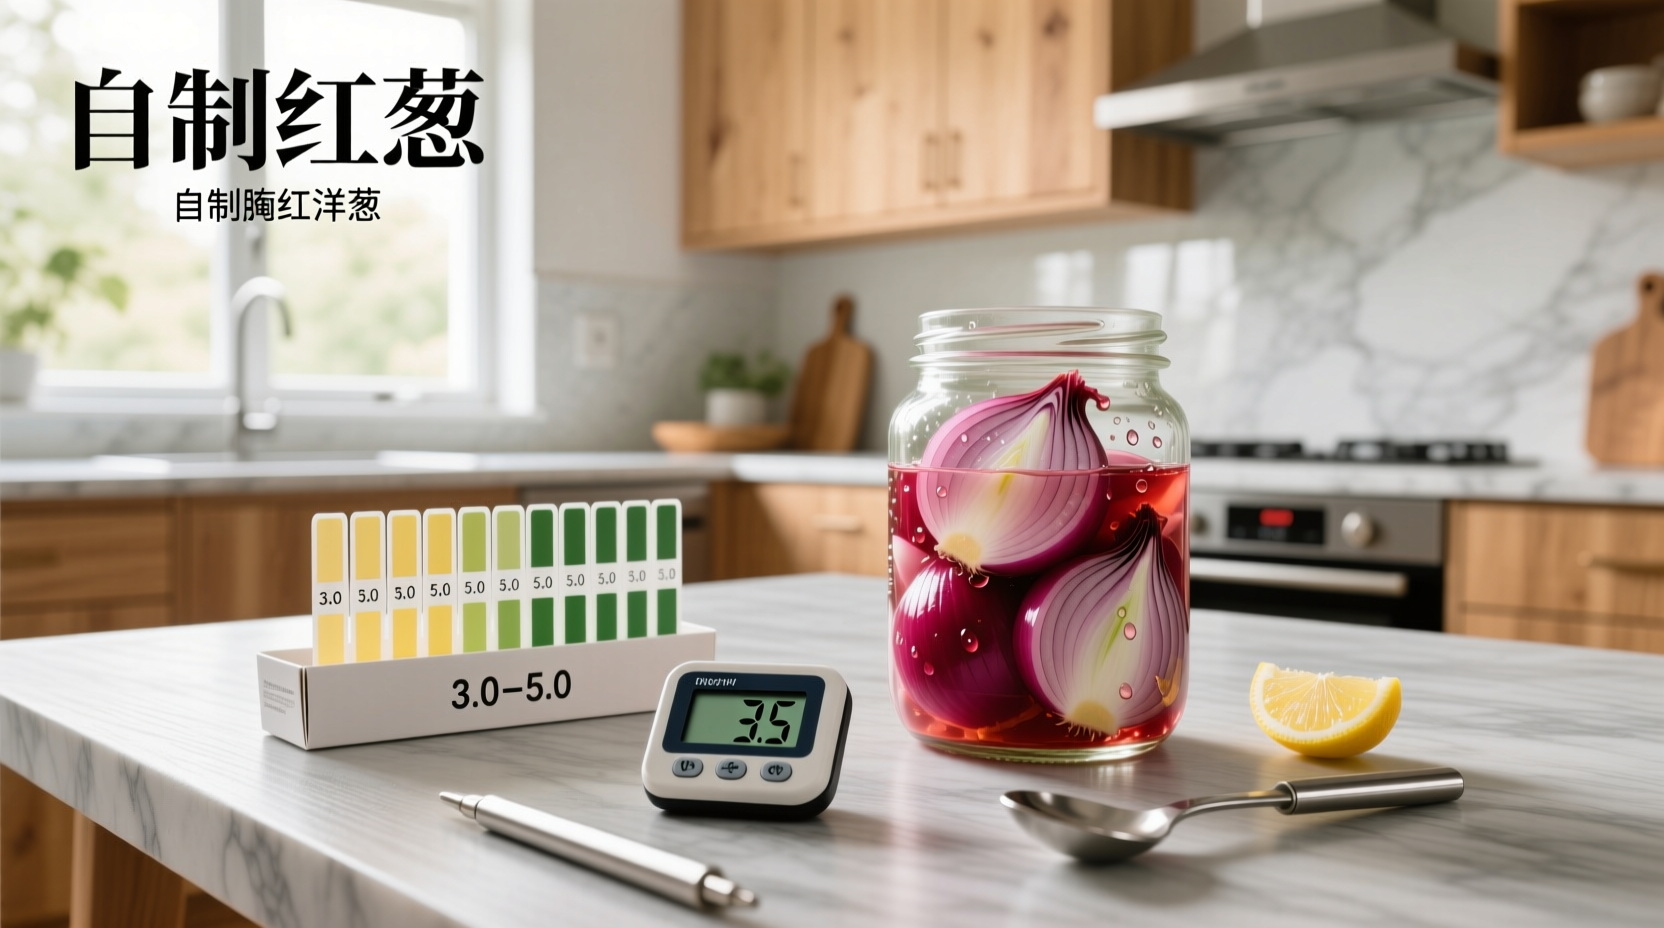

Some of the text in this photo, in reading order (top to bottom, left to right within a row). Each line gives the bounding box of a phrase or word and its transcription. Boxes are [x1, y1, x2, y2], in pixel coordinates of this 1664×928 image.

[566, 573, 585, 587] 5.0
[657, 567, 677, 581] 5.0
[430, 582, 451, 597] 5.0
[464, 580, 486, 595] 5.0
[499, 578, 520, 592] 5.0
[533, 576, 553, 590] 5.0
[319, 591, 342, 606] 3.0
[358, 588, 379, 603] 5.0
[394, 585, 416, 601] 5.0
[733, 699, 796, 745] 3.5
